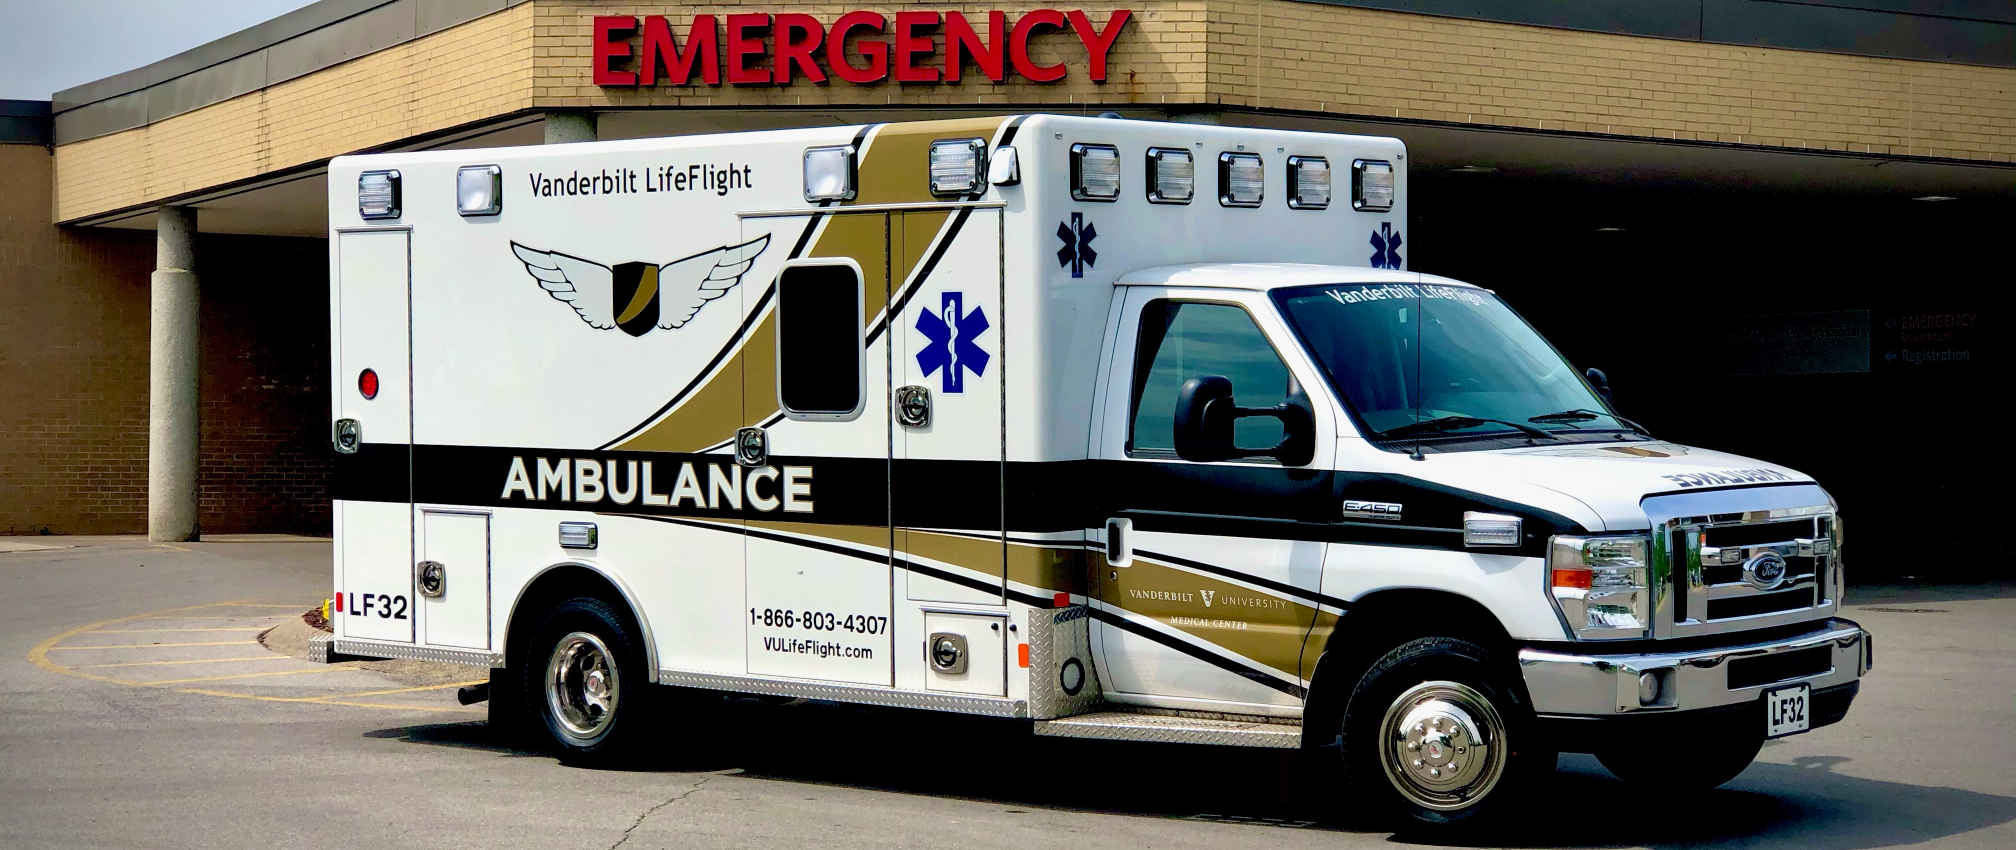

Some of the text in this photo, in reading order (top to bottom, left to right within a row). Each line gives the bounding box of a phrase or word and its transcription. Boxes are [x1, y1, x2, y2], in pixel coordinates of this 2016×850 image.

[592, 8, 1133, 87] EMERGENCY
[529, 163, 753, 199] Vanderbilt LifeFlight
[1325, 284, 1490, 307] Vanderbilt LifeFlight
[1902, 312, 1977, 330] EMERGENCY
[1902, 348, 1970, 365] Registration
[500, 456, 815, 514] AMBULANCE
[349, 592, 408, 621] LF32
[1129, 589, 1194, 603] VANDERBILT
[1221, 595, 1287, 610] UNIVERSITY
[749, 607, 888, 636] 1-866-803-4307
[1170, 615, 1248, 631] MEDICAL CENTER
[763, 636, 873, 660] VULifeFlight.com
[1771, 696, 1805, 727] LF32
